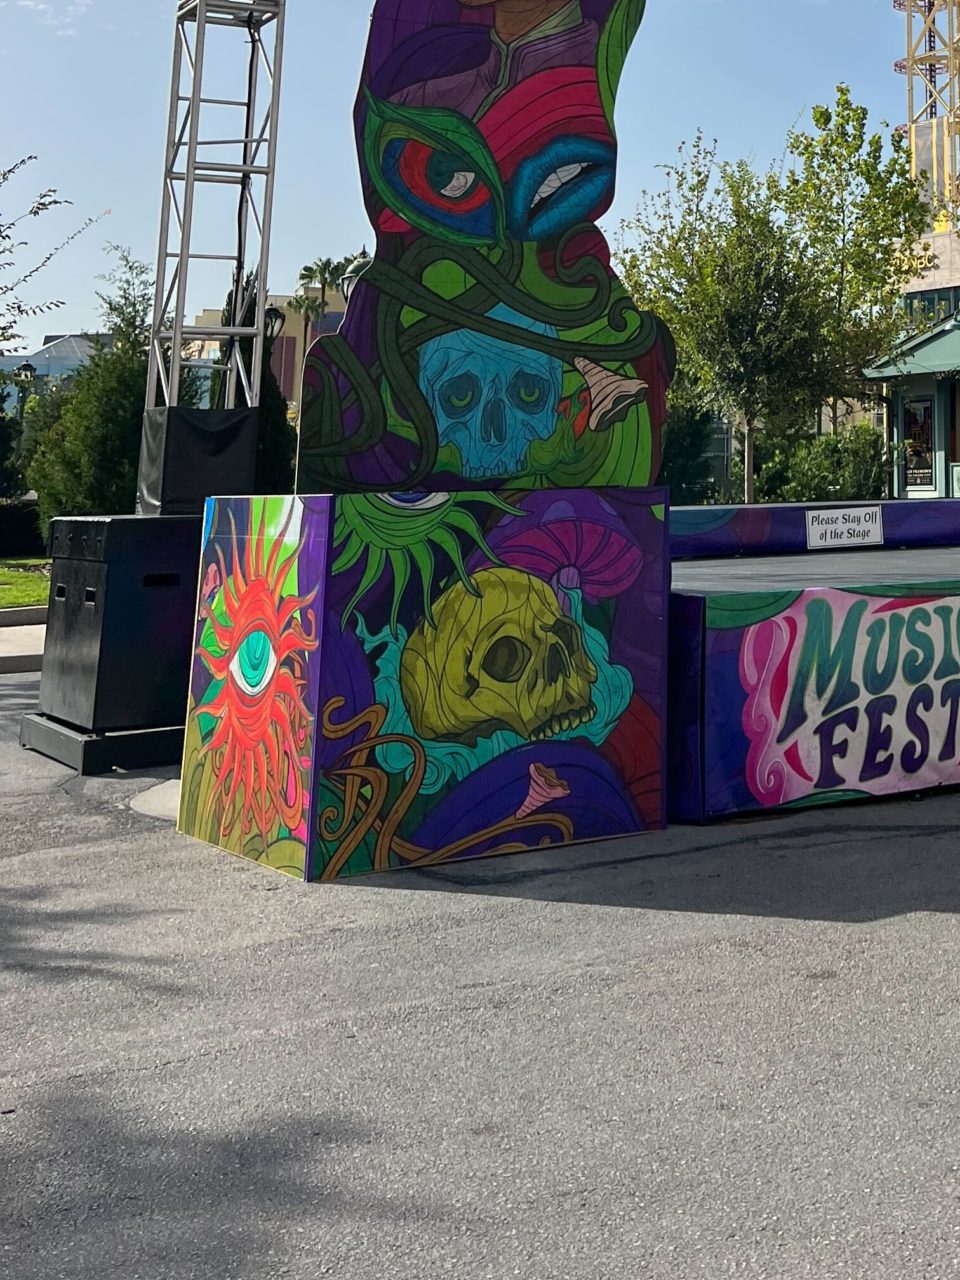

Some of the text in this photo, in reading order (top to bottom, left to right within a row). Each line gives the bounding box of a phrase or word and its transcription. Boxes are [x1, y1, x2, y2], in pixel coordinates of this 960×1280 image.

[811, 510, 878, 526] Please Stay Off
[819, 527, 871, 542] of the Stage
